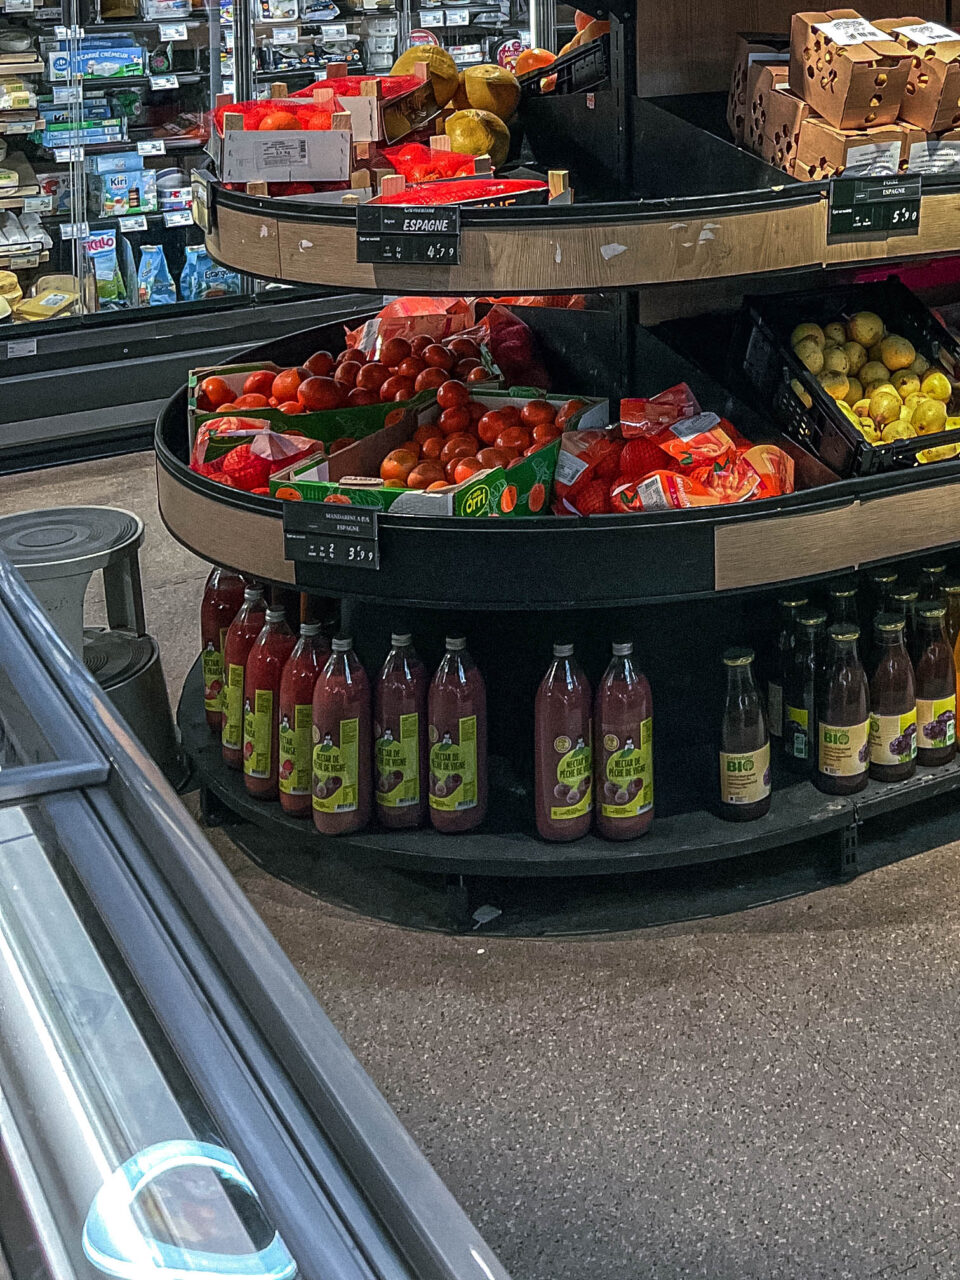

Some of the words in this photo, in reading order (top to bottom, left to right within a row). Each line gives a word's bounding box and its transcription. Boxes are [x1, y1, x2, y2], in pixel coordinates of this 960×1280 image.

[110, 176, 128, 187] Kiri
[882, 187, 906, 196] ESPAGNE
[403, 219, 449, 231] ESPAGNE
[336, 524, 360, 532] ESPAGNE
[823, 732, 850, 745] BIO
[726, 760, 755, 773] BIO
